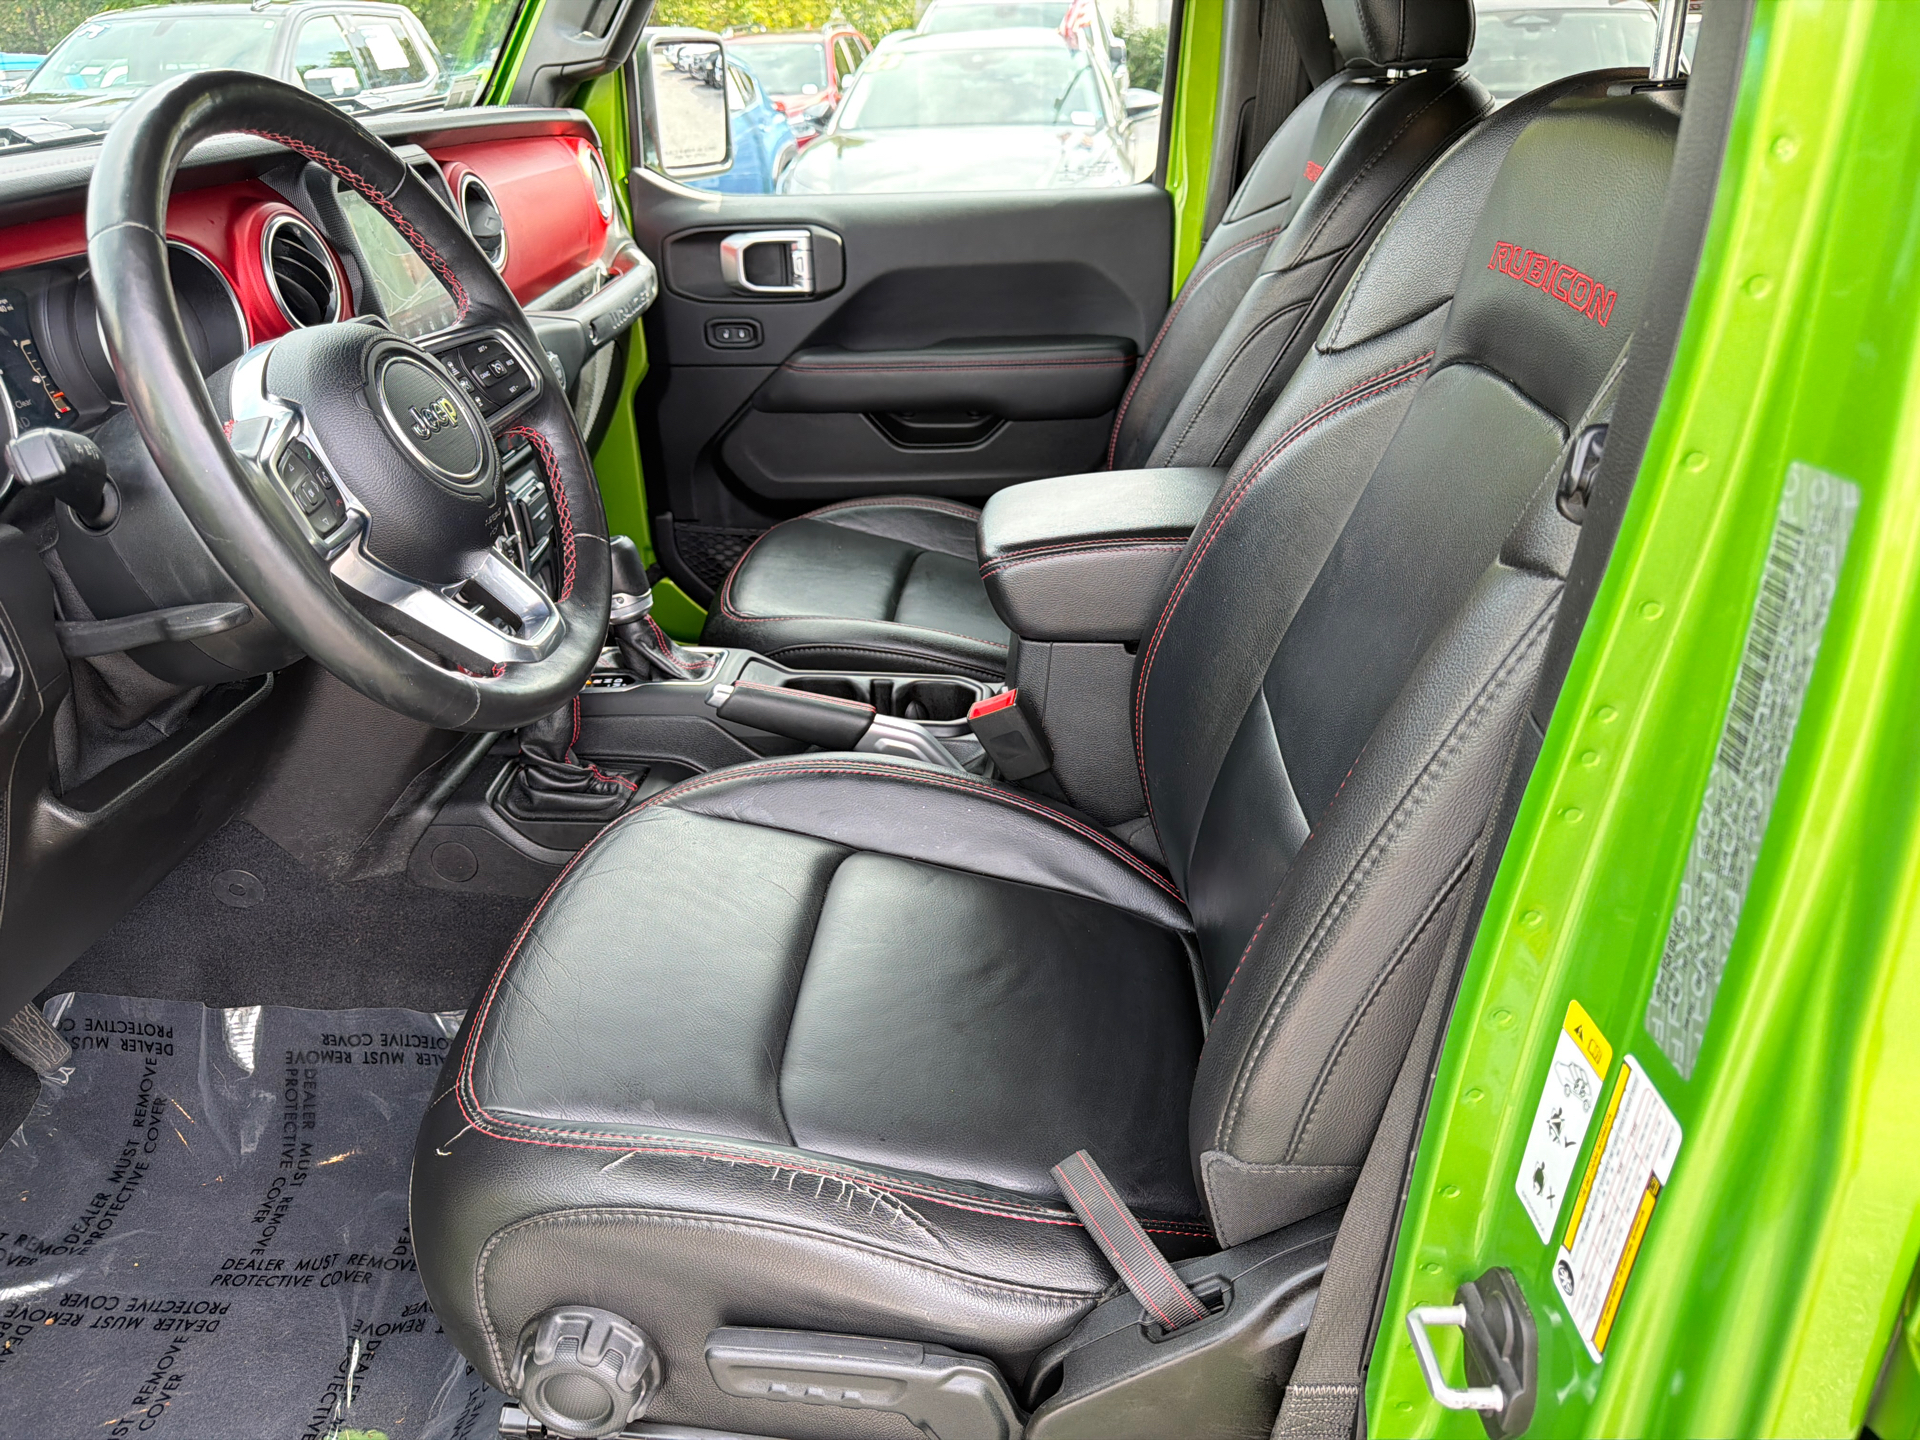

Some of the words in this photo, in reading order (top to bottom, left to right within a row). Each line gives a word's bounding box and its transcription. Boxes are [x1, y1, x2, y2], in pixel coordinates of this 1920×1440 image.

[1487, 241, 1617, 327] RUBICON
[408, 396, 459, 440] Jeep
[85, 1018, 173, 1039] PROTECTIVE
[66, 1036, 109, 1050] MUS
[121, 1038, 174, 1057] DEALER
[321, 1033, 373, 1047] COVER
[380, 1033, 450, 1049] OTECTIVE
[285, 1050, 352, 1065] REMOVE
[362, 1051, 404, 1065] MUST
[301, 1068, 318, 1130] DEALER
[279, 1068, 299, 1169] PROTECTIVE
[64, 1192, 112, 1245] DEALER
[108, 1139, 140, 1183] MUST
[133, 1057, 157, 1128] REMOVE
[82, 1161, 150, 1246] PROTECTIVE
[143, 1097, 168, 1154] COVER
[290, 1142, 313, 1187] MUST
[251, 1177, 287, 1223] COVER
[250, 1196, 294, 1256] REMOVE
[13, 1233, 91, 1256] REMOVE
[221, 1258, 285, 1271] DEALER
[294, 1253, 340, 1271] MUST
[347, 1253, 417, 1272] REMOVE
[210, 1274, 314, 1288] PROTECTIVE
[320, 1271, 373, 1287] COVER
[59, 1293, 119, 1311] COVER
[125, 1297, 231, 1315] PROTECTIVE
[4, 1302, 84, 1327] REMOVE
[90, 1315, 145, 1330] MUST
[153, 1318, 220, 1333] DEALER
[350, 1318, 426, 1336] REMOVE
[132, 1336, 189, 1406] REMOVE
[138, 1373, 186, 1431] COVER
